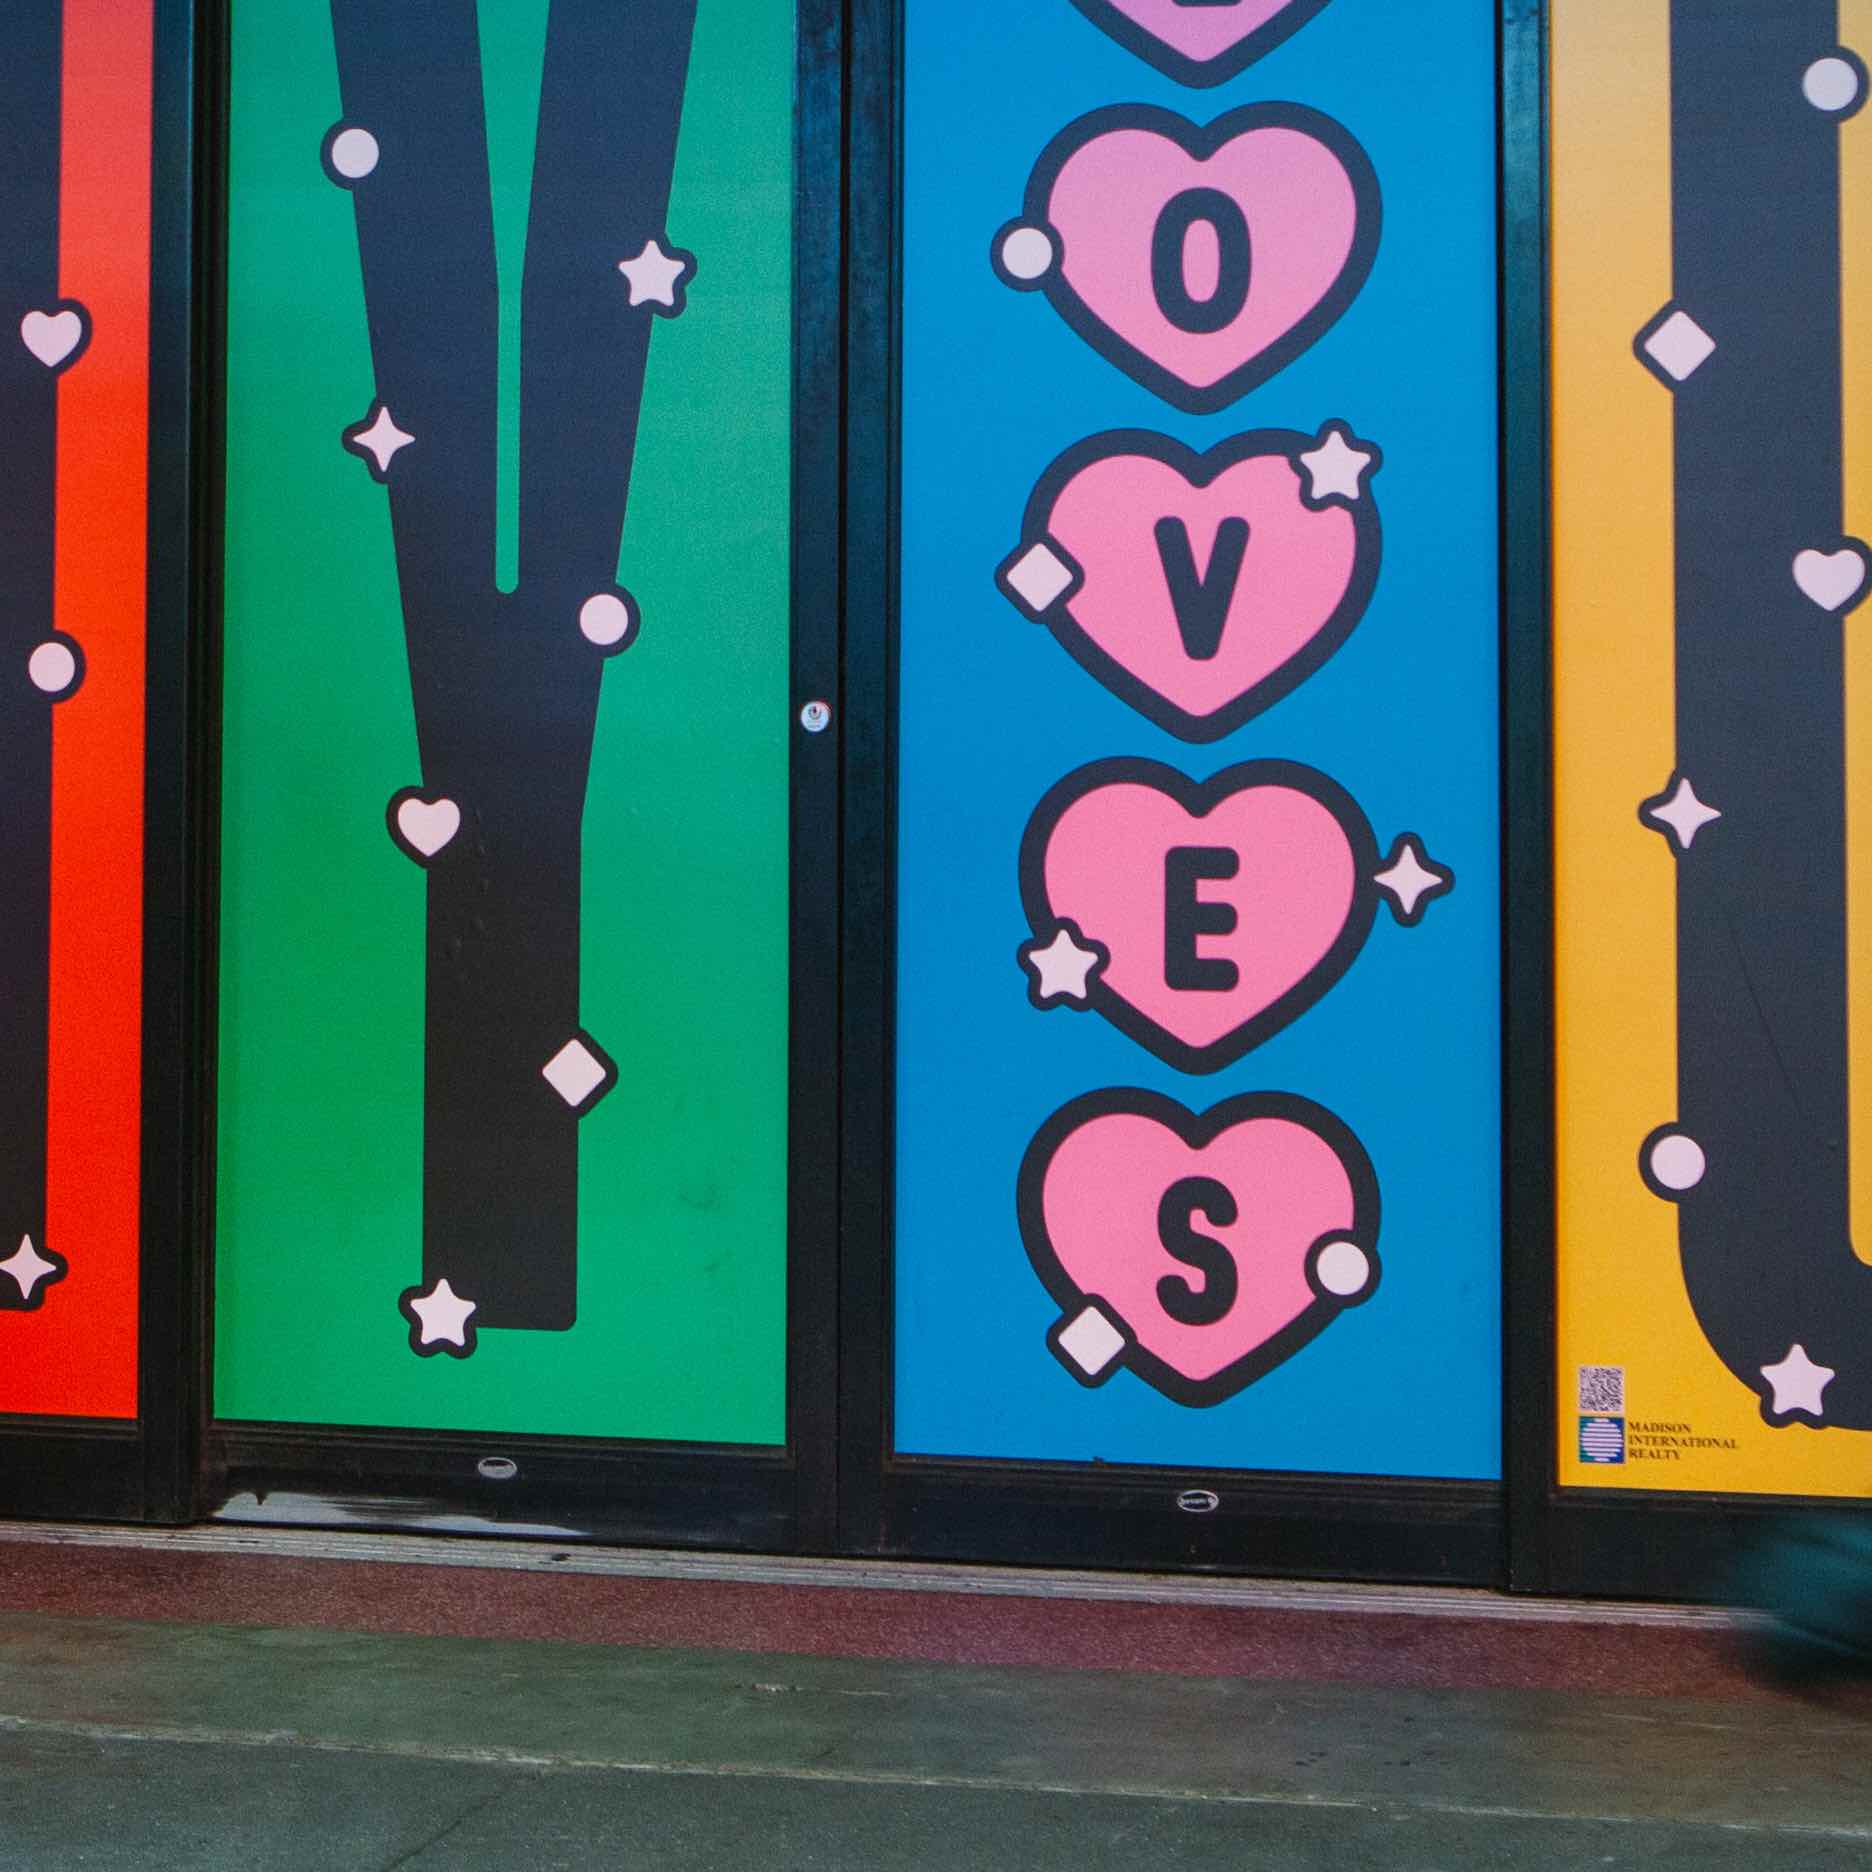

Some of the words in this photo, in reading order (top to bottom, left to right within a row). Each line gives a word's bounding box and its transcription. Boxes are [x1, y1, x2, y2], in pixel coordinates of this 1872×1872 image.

[1628, 1421, 1691, 1433] MADISON
[1628, 1435, 1737, 1449] INTERNATIONAL
[1628, 1448, 1680, 1460] REALTY
